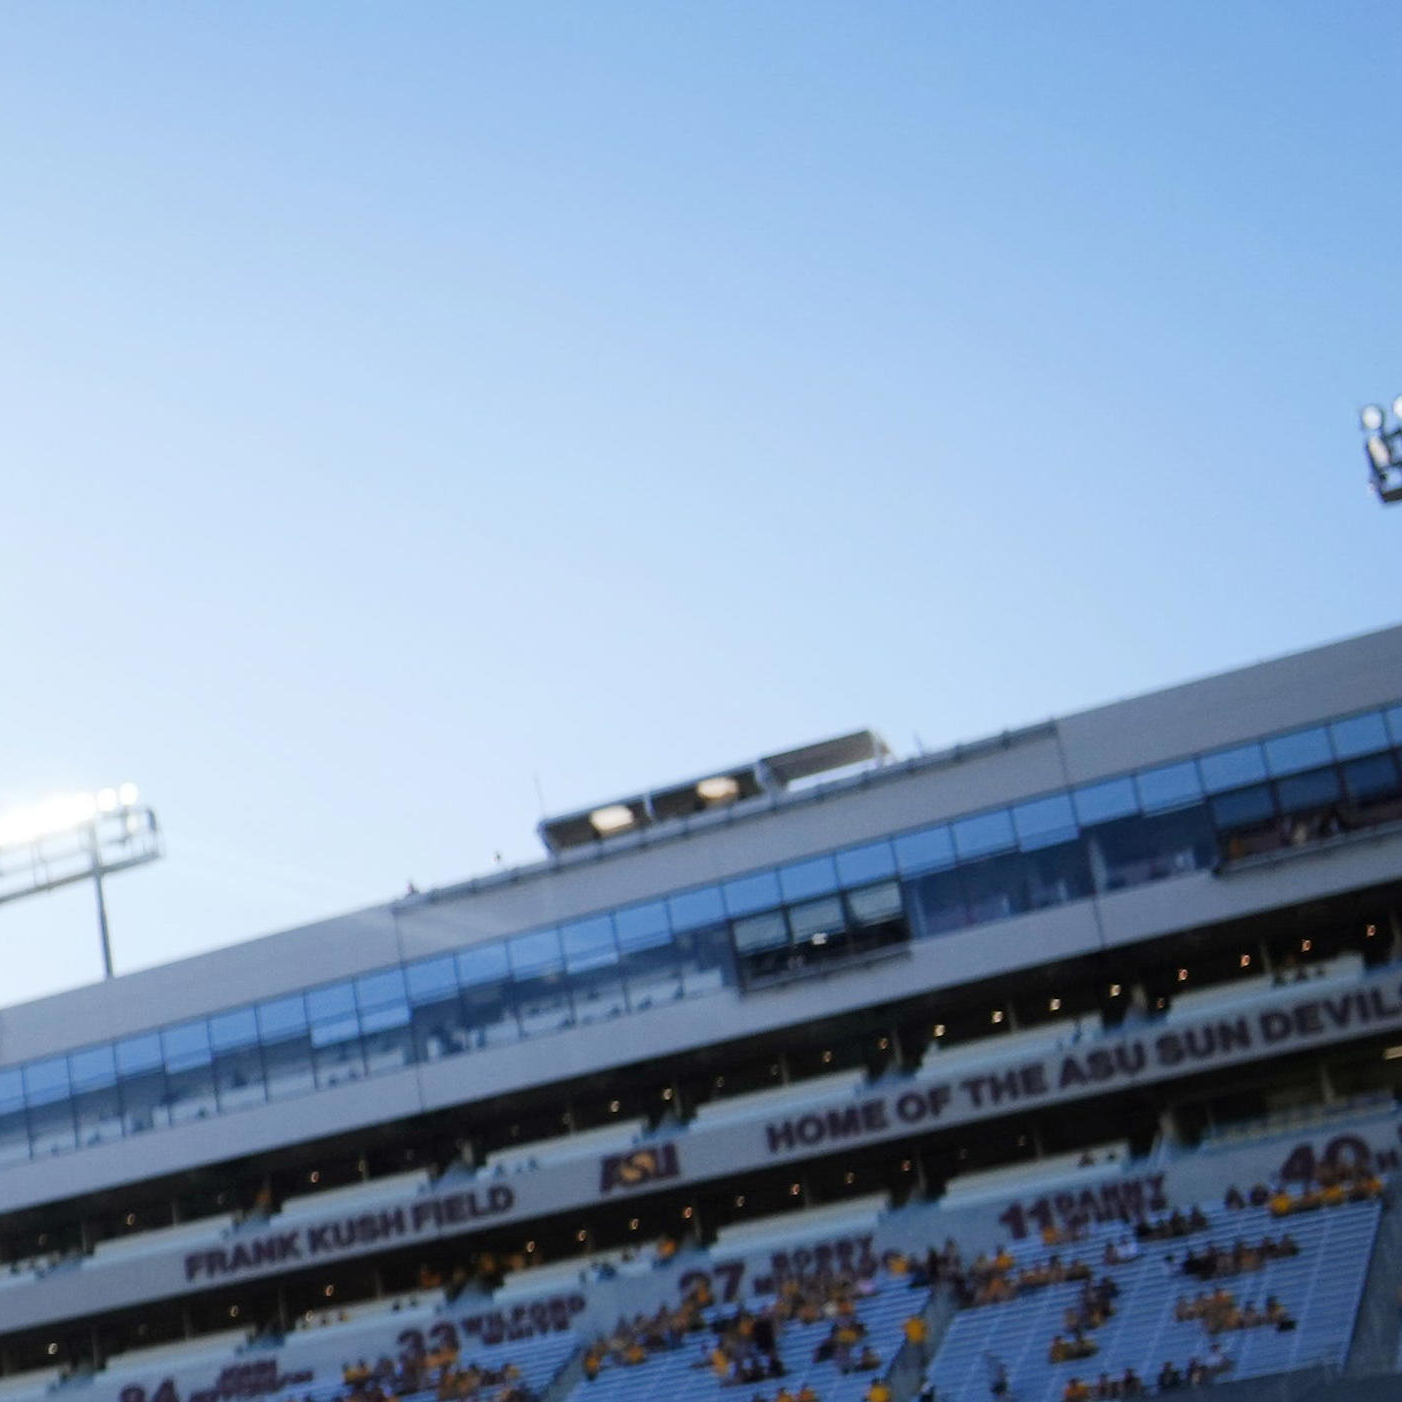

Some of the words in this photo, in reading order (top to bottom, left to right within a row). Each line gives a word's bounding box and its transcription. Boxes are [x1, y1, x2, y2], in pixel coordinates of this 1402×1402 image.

[765, 1100, 888, 1153] HOME
[896, 1085, 951, 1123] OF
[960, 1062, 1048, 1108] THE
[1058, 1040, 1146, 1089] ASU
[1154, 1018, 1252, 1066] SUN
[1259, 982, 1402, 1045] DEVIL
[183, 1229, 300, 1283] FRANK
[307, 1205, 408, 1256] KUSH
[412, 1184, 515, 1233] FIELD
